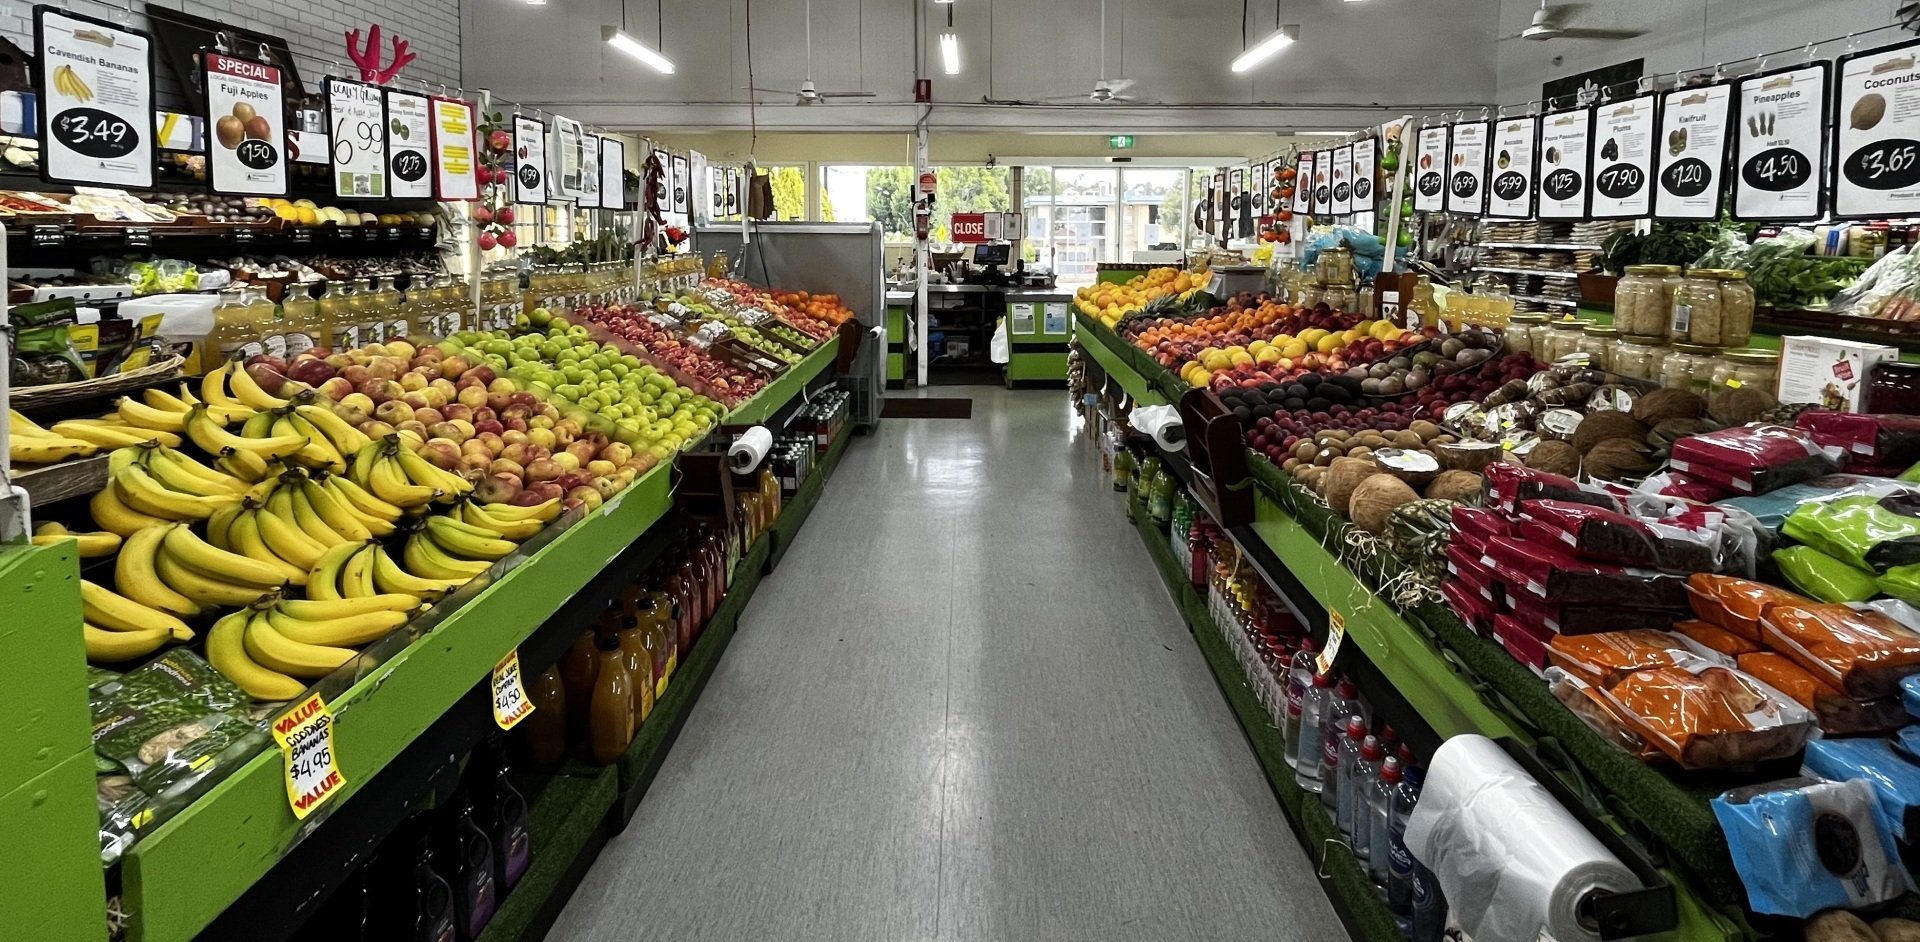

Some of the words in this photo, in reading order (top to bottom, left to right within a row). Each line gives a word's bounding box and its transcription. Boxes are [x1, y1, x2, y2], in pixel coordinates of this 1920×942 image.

[48, 46, 96, 65] Cavendish
[99, 58, 139, 74] Bananas
[217, 58, 270, 80] SPECIAL
[221, 84, 238, 97] Fuji
[240, 87, 269, 100] Apples
[1864, 73, 1920, 90] Coconuts
[1753, 89, 1801, 105] Pineapples
[60, 115, 127, 143] $3.49
[1755, 155, 1799, 182] $4.50
[1862, 146, 1916, 179] $3.65
[1601, 168, 1638, 191] $7.90
[275, 698, 323, 735] VALUE
[500, 701, 532, 725] VALUE
[286, 714, 331, 747] GOODNESS
[291, 727, 329, 761] BANANAS
[290, 747, 331, 780] $4.95
[294, 770, 342, 810] VALUE
